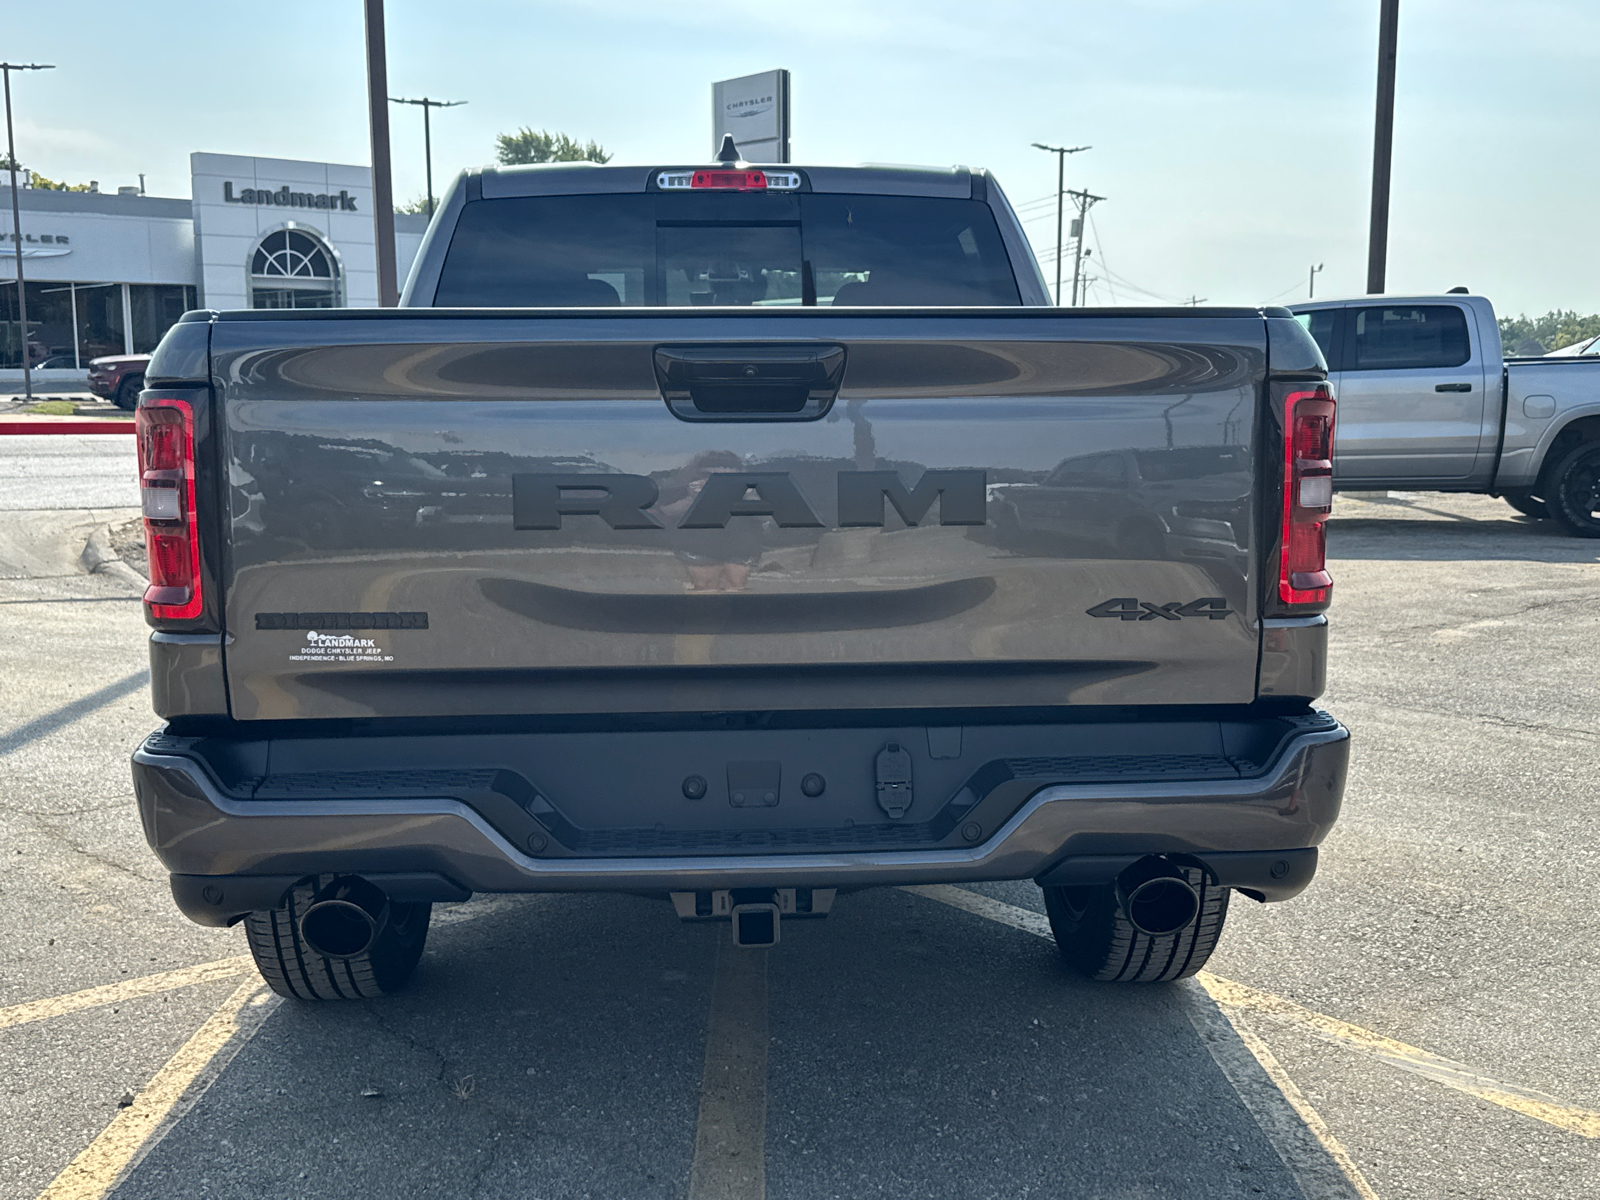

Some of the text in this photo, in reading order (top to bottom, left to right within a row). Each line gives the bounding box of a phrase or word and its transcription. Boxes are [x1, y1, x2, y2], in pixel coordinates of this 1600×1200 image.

[726, 96, 773, 111] CHRYSLER
[224, 181, 358, 212] Landmark
[512, 469, 987, 531] RAM
[1085, 597, 1235, 621] 4x4
[318, 639, 375, 647] LANDMARK
